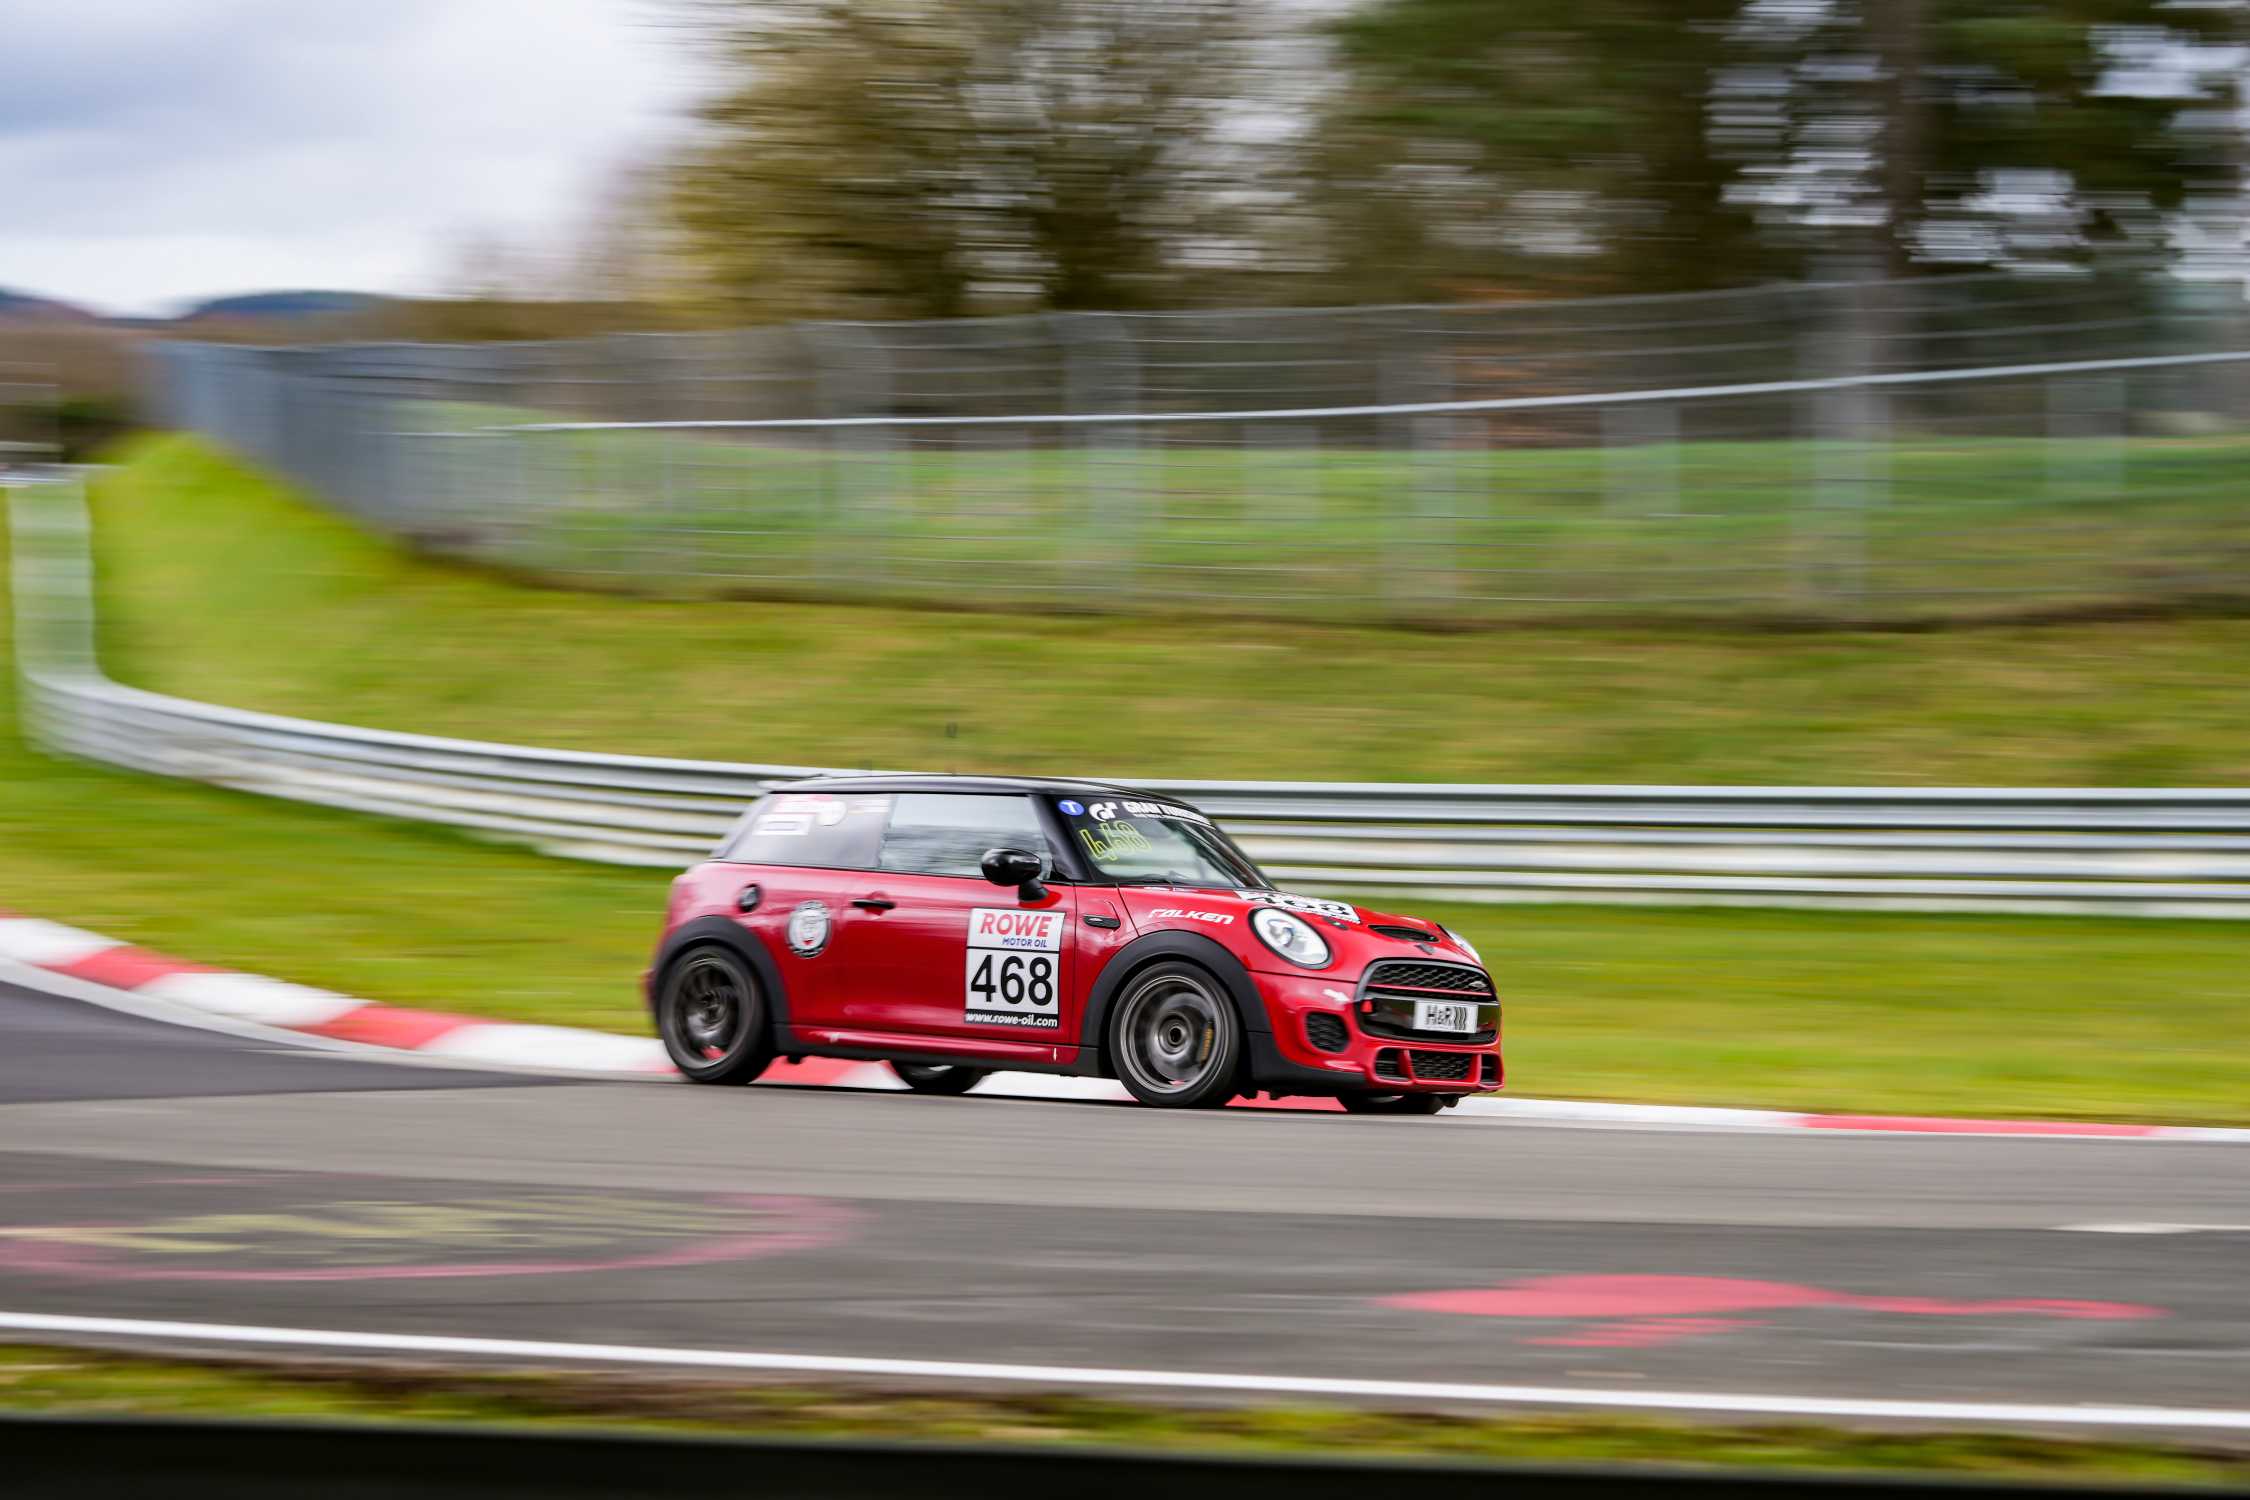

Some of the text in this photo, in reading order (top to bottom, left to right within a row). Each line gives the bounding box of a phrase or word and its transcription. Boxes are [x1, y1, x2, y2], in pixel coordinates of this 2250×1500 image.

[980, 912, 1053, 938] ROWE
[1148, 907, 1234, 925] FALKEN
[1002, 937, 1048, 949] MOTOR OIL
[970, 954, 1053, 1007] 468
[966, 1012, 1058, 1028] www.rowe-oil.com
